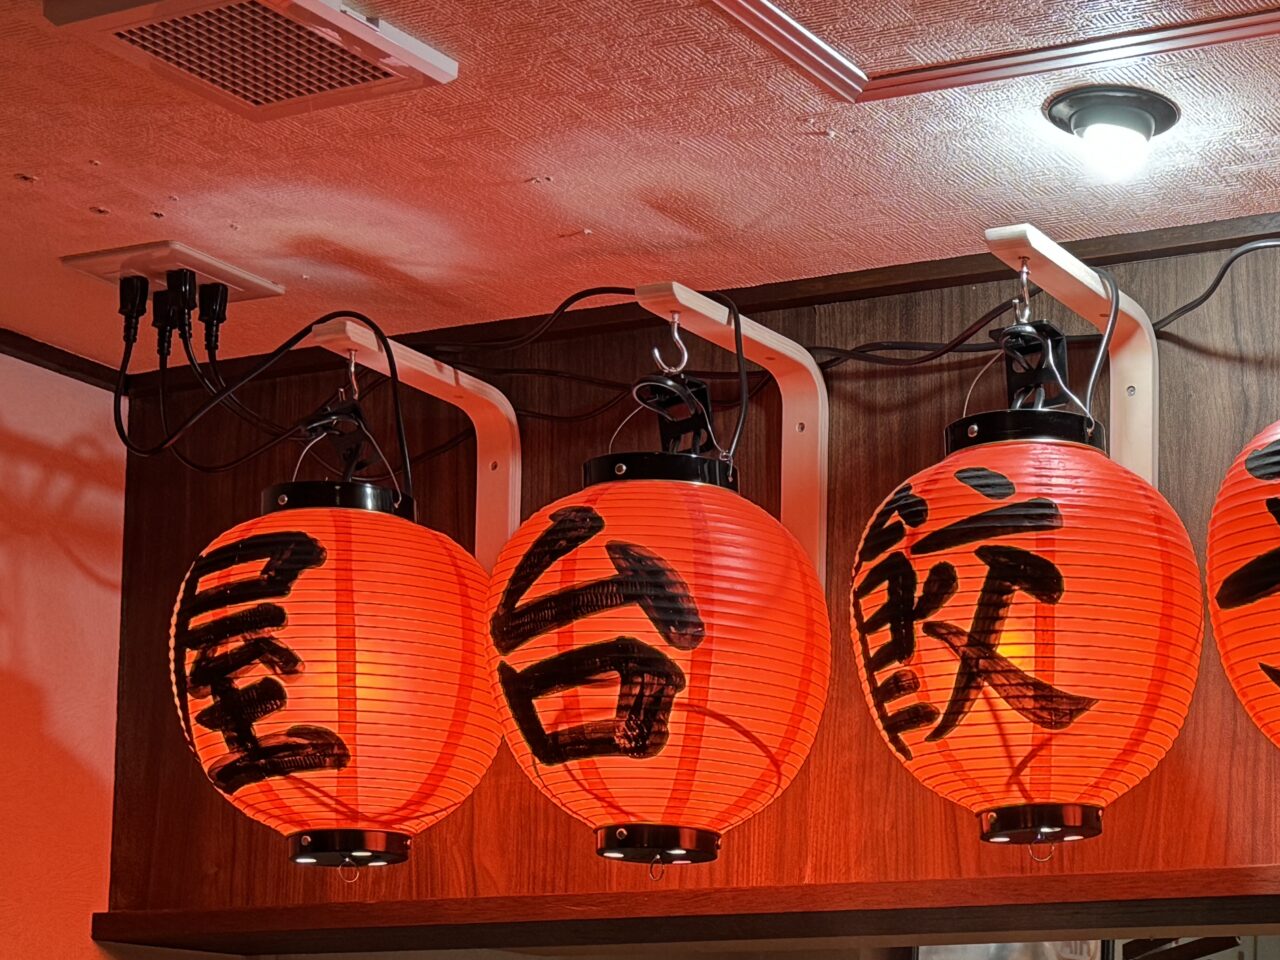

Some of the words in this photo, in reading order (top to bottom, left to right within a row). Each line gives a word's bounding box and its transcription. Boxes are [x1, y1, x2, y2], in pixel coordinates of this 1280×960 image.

[170, 531, 351, 794] 屋
[489, 506, 705, 766] 台
[851, 467, 1098, 761] 餃
